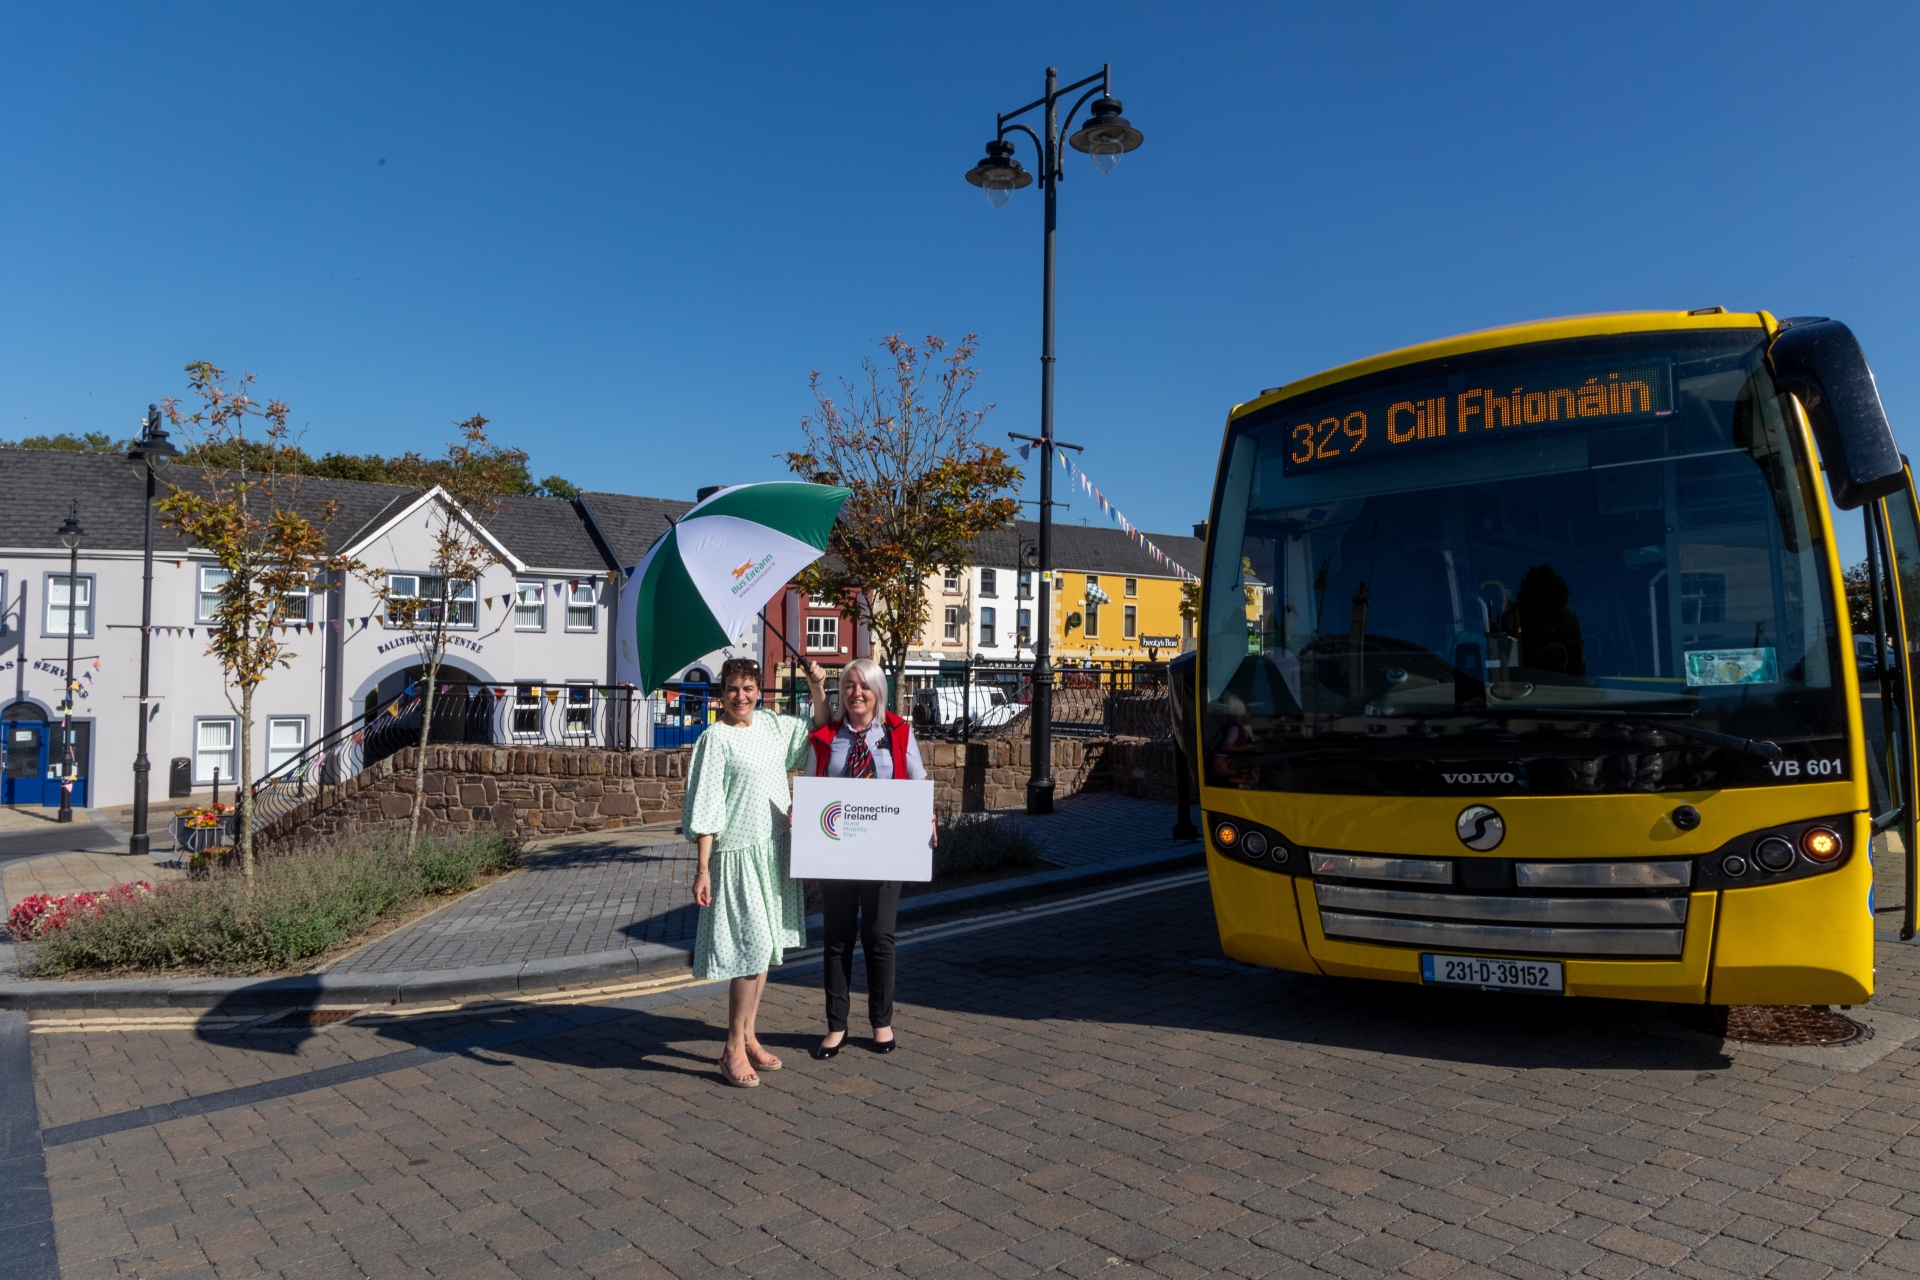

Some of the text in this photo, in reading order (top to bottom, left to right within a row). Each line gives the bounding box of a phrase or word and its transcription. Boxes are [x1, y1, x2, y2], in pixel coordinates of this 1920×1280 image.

[1292, 373, 1650, 464] 329 Cill Fhíonáin
[731, 553, 773, 595] Bus Éireann
[1769, 758, 1842, 777] VB 601
[1441, 772, 1514, 784] VOLVO
[844, 804, 900, 815] Connecting
[844, 812, 877, 821] Ireland
[1445, 960, 1549, 987] 231-D-39152
